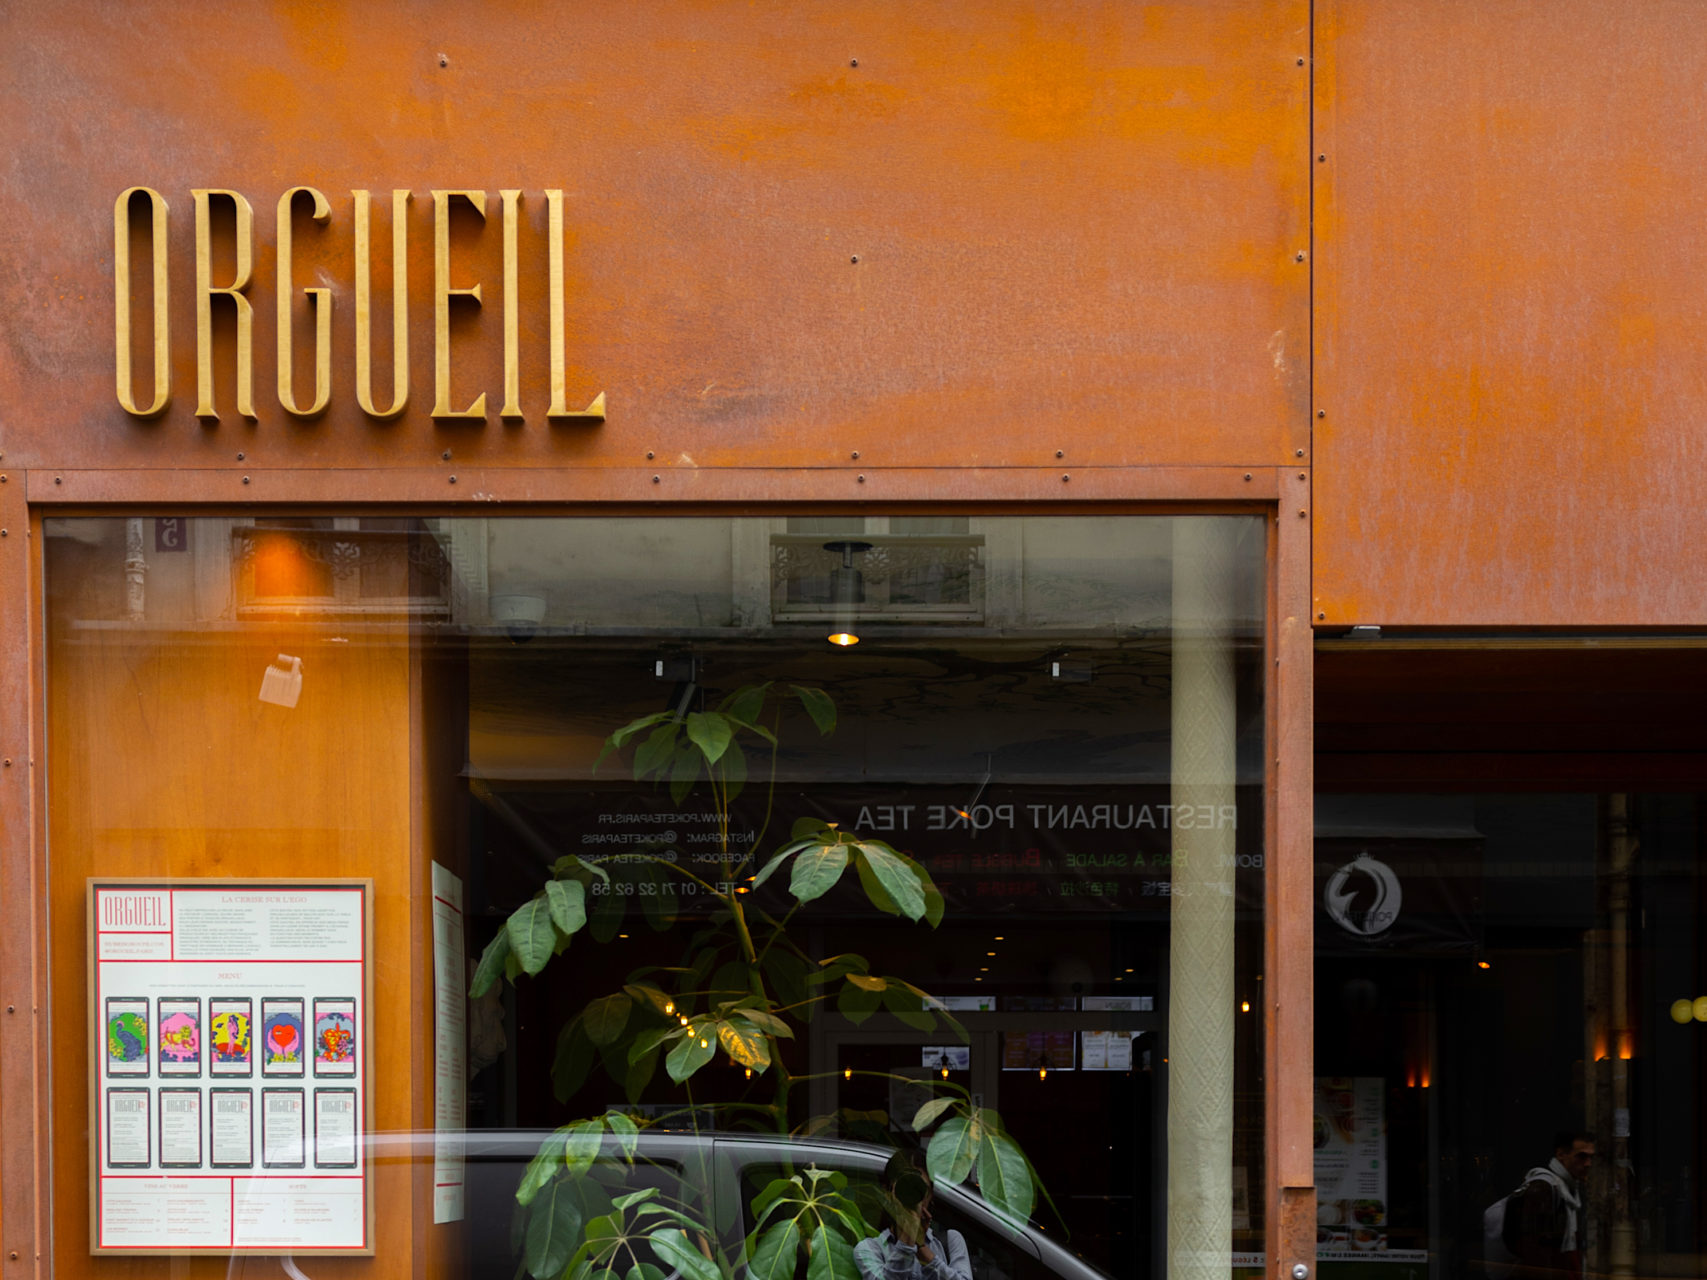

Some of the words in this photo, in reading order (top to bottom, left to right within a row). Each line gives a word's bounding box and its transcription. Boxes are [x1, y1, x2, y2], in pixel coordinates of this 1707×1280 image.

[113, 186, 607, 422] ORGUEIL
[104, 896, 167, 926] ORGUEIL
[217, 972, 243, 980] MENU
